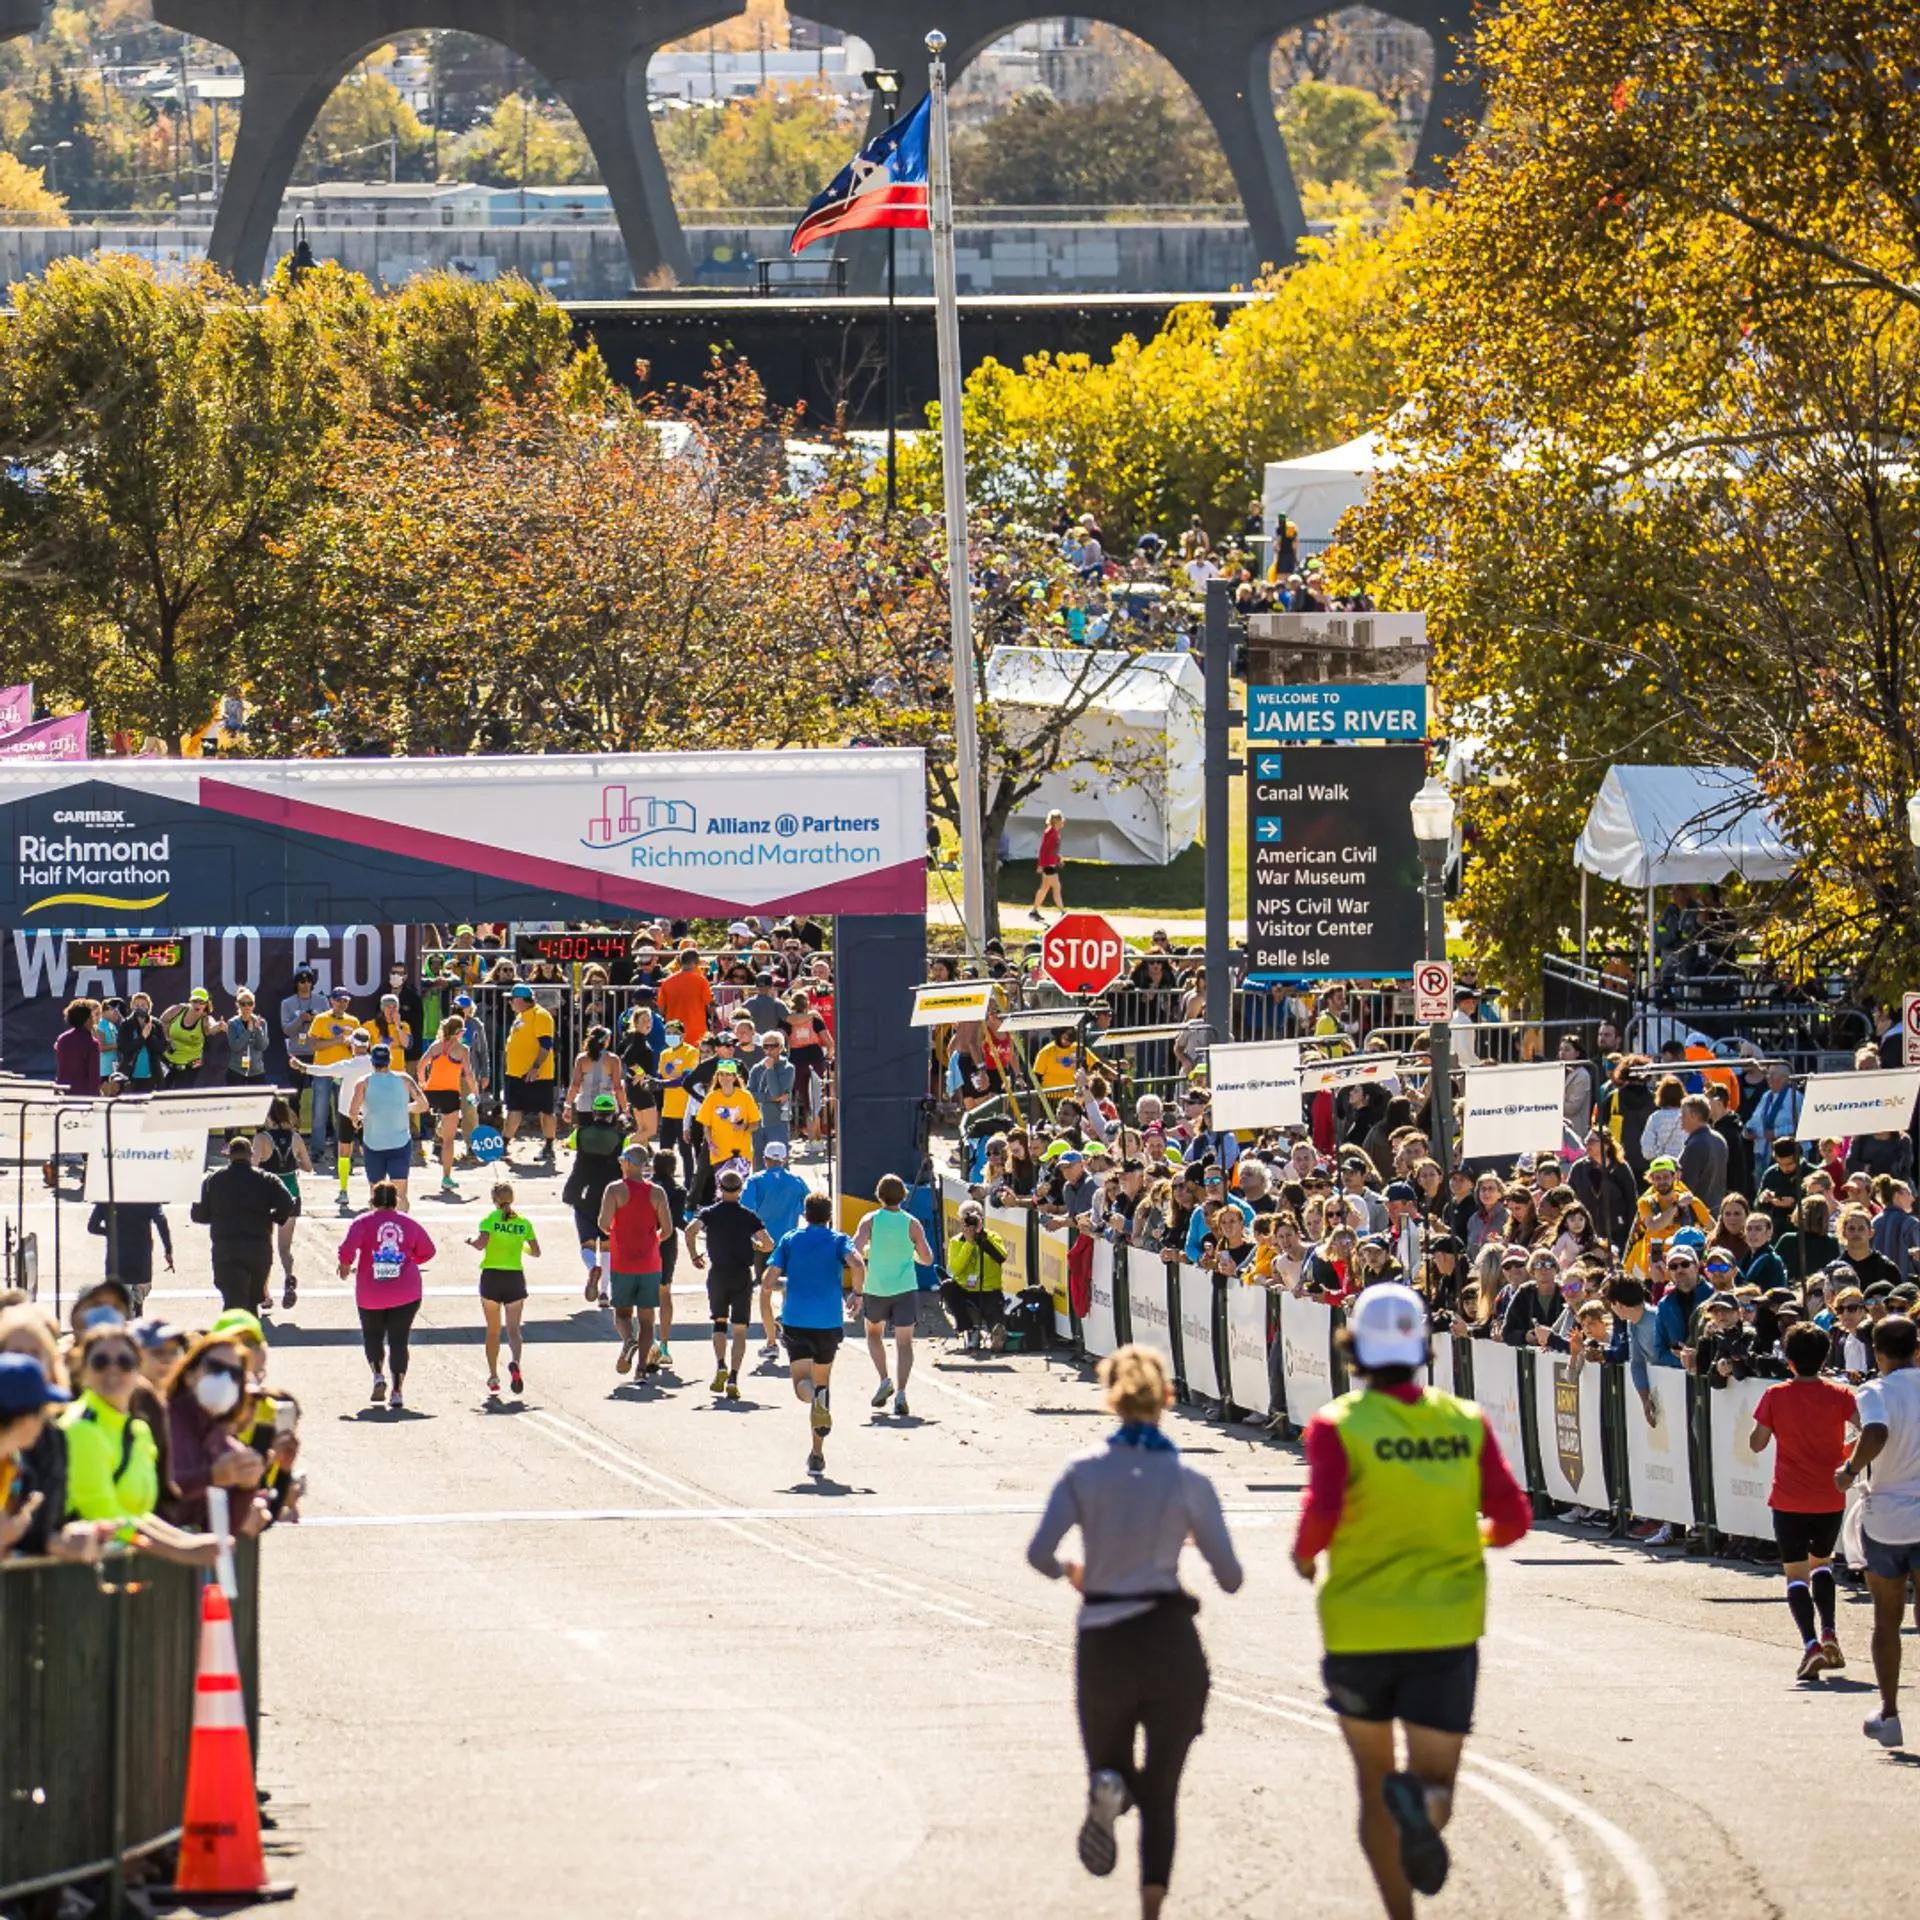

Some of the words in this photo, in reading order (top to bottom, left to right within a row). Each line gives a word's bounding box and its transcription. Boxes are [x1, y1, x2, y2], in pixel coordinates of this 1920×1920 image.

[1256, 693, 1318, 704] WELCOME
[1323, 693, 1340, 704] TO
[1253, 710, 1336, 732] JAMES
[1344, 709, 1418, 731] RIVER
[1256, 784, 1302, 801] Canal
[1308, 784, 1349, 801] Walk
[707, 817, 771, 834] Allianz
[803, 815, 880, 833] Partners
[20, 834, 170, 862] Richmond
[631, 845, 753, 867] Richmond
[758, 841, 880, 865] Marathon
[1256, 847, 1336, 864] American
[1341, 846, 1377, 863] Civil
[20, 865, 61, 885] Half
[67, 864, 170, 884] Marathon
[1256, 870, 1290, 885] War
[1294, 869, 1366, 885] Museum
[1257, 899, 1291, 915] NPS
[1296, 898, 1331, 914] Civil
[1337, 898, 1370, 914] War
[1256, 920, 1312, 936] Visitor
[1317, 920, 1373, 935] Center
[13, 928, 154, 998] WAY
[179, 925, 261, 997] TO
[293, 925, 406, 997] GO!
[1048, 938, 1118, 970] STOP
[1257, 949, 1297, 966] Belle
[1302, 949, 1330, 965] Isle
[1260, 1079, 1296, 1089] Partners
[1470, 1107, 1502, 1117] Allianz
[1518, 1103, 1559, 1113] Partners
[1813, 1098, 1882, 1113] Walmart
[471, 1135, 503, 1152] 4:00
[101, 1146, 171, 1162] Walmart
[494, 1222, 525, 1236] PACER
[1374, 1435, 1471, 1461] COACH
